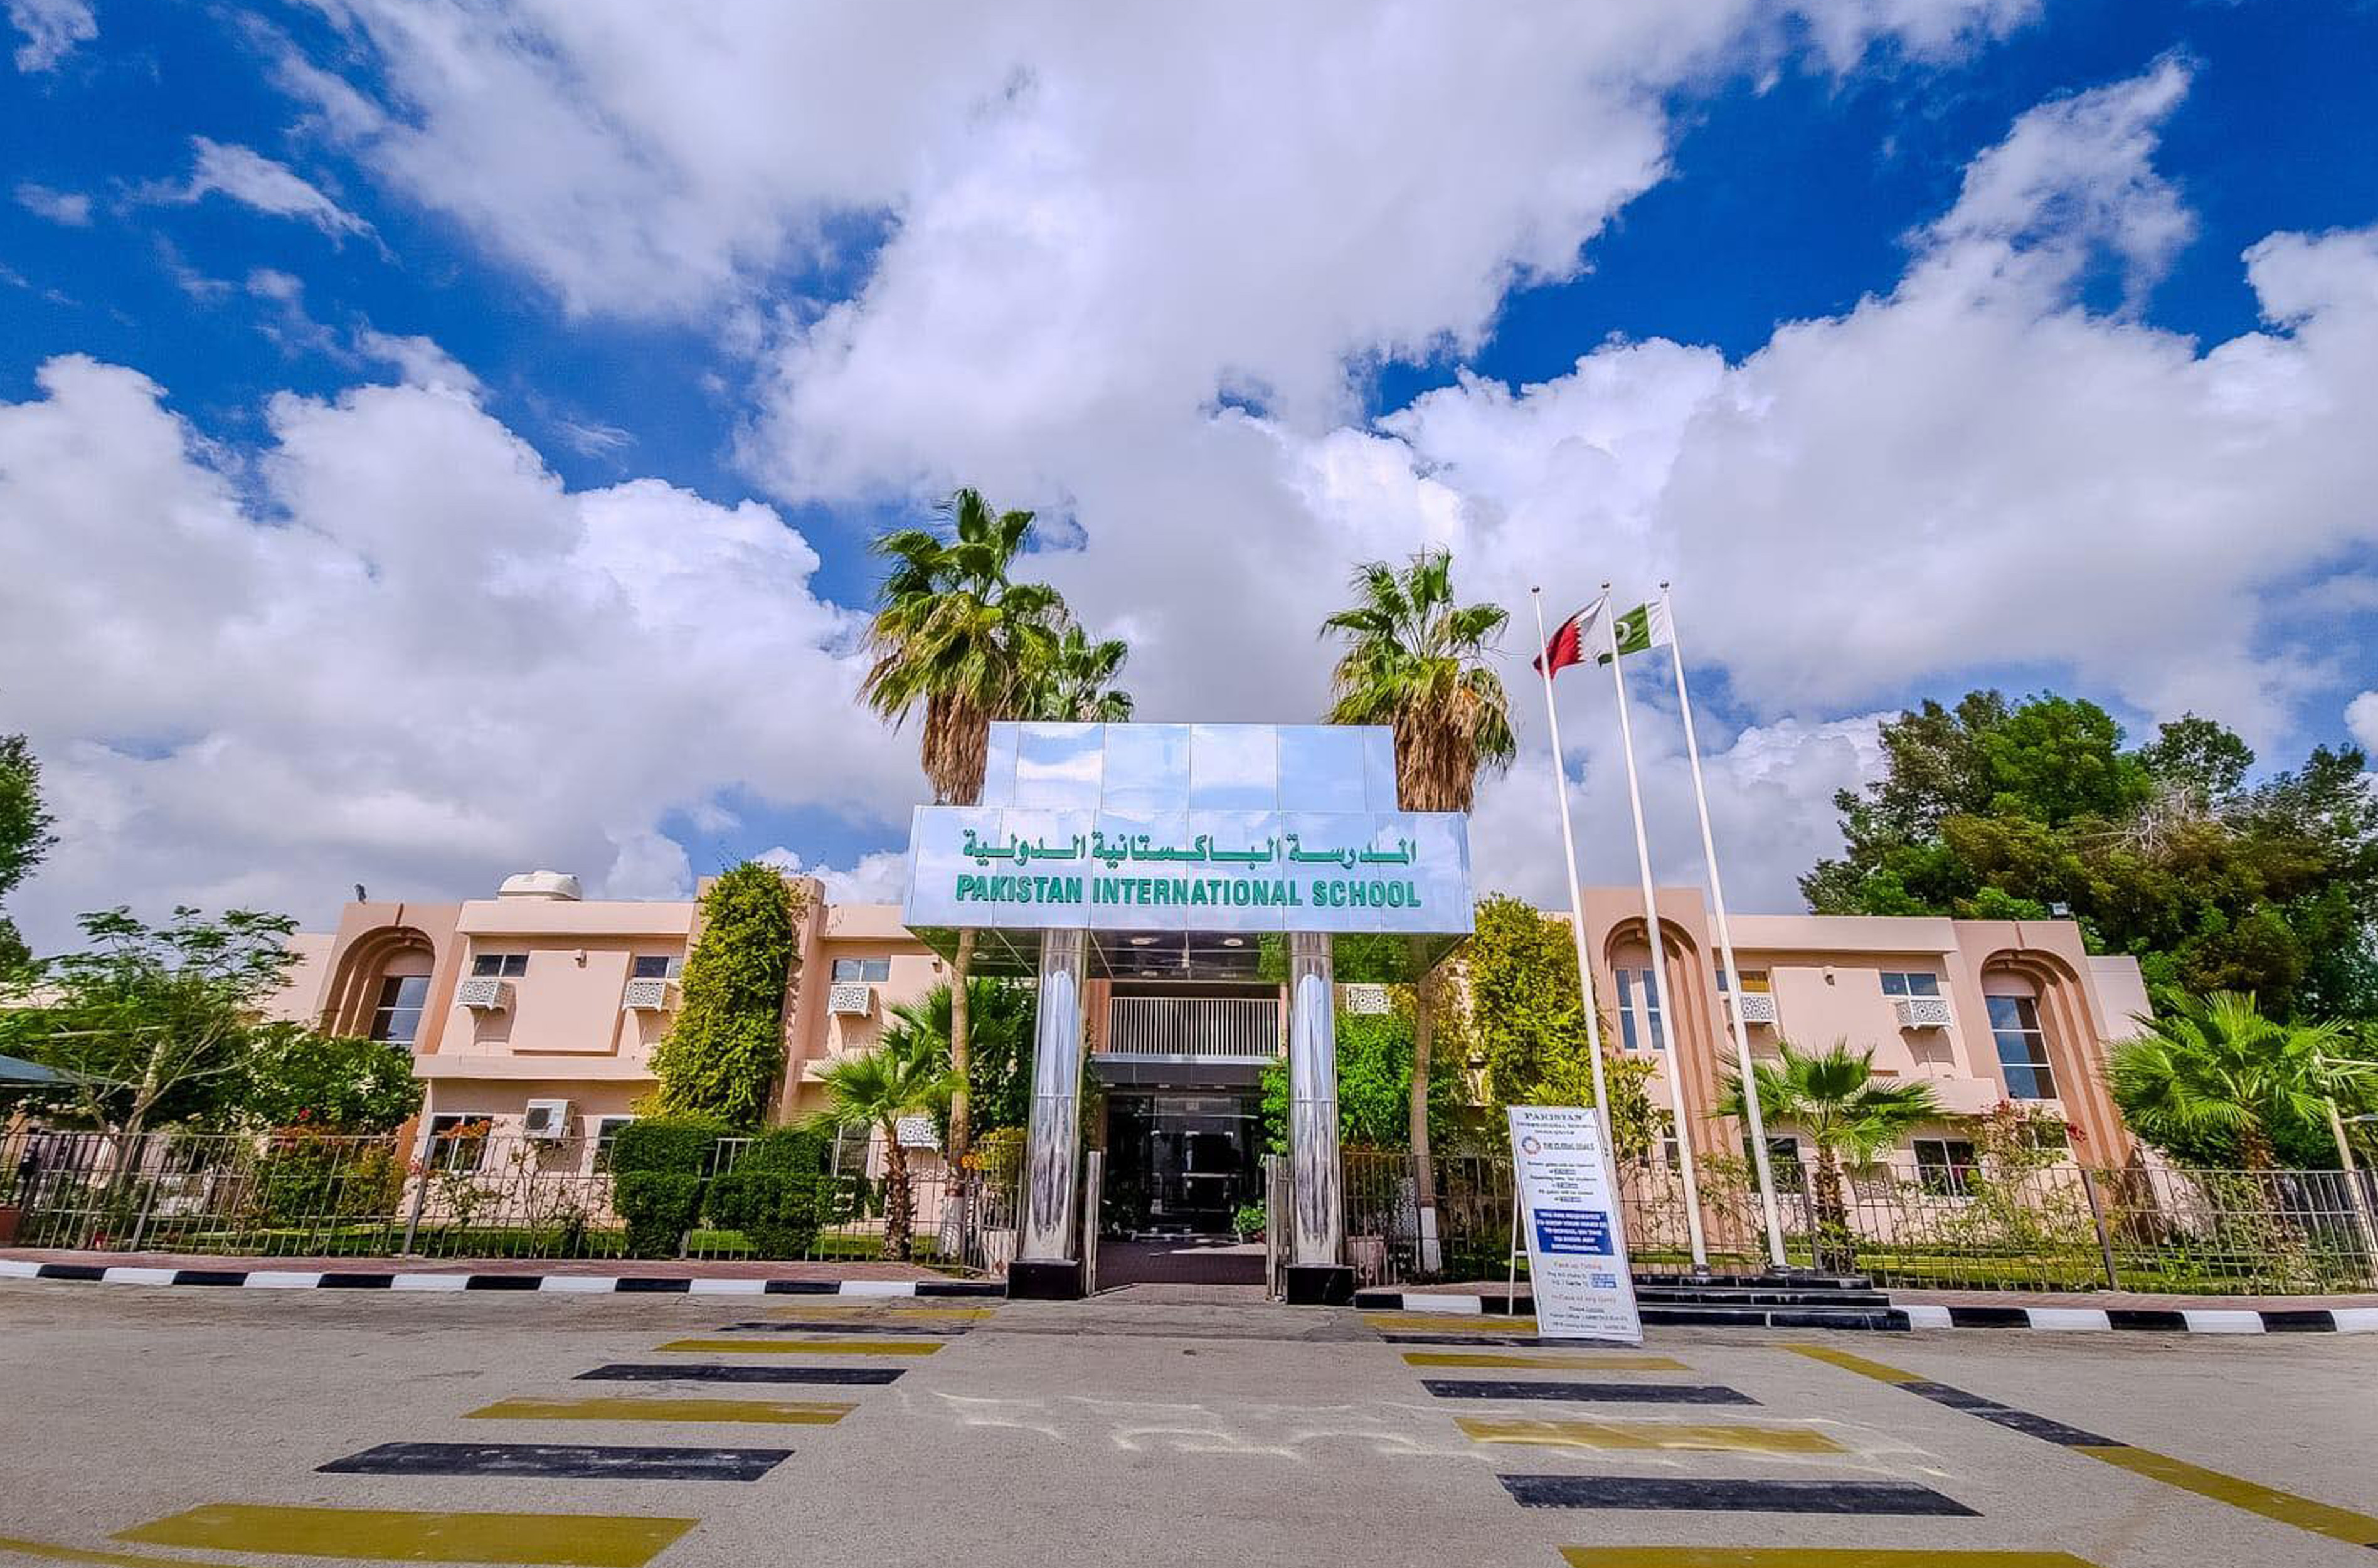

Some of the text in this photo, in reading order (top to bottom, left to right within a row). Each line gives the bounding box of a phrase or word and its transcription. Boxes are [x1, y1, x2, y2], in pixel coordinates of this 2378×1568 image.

[962, 828, 1418, 870] المدرسة الباكستانية الدولية
[955, 874, 1422, 908] PAKISTAN INTERNATIONAL SCHOOL
